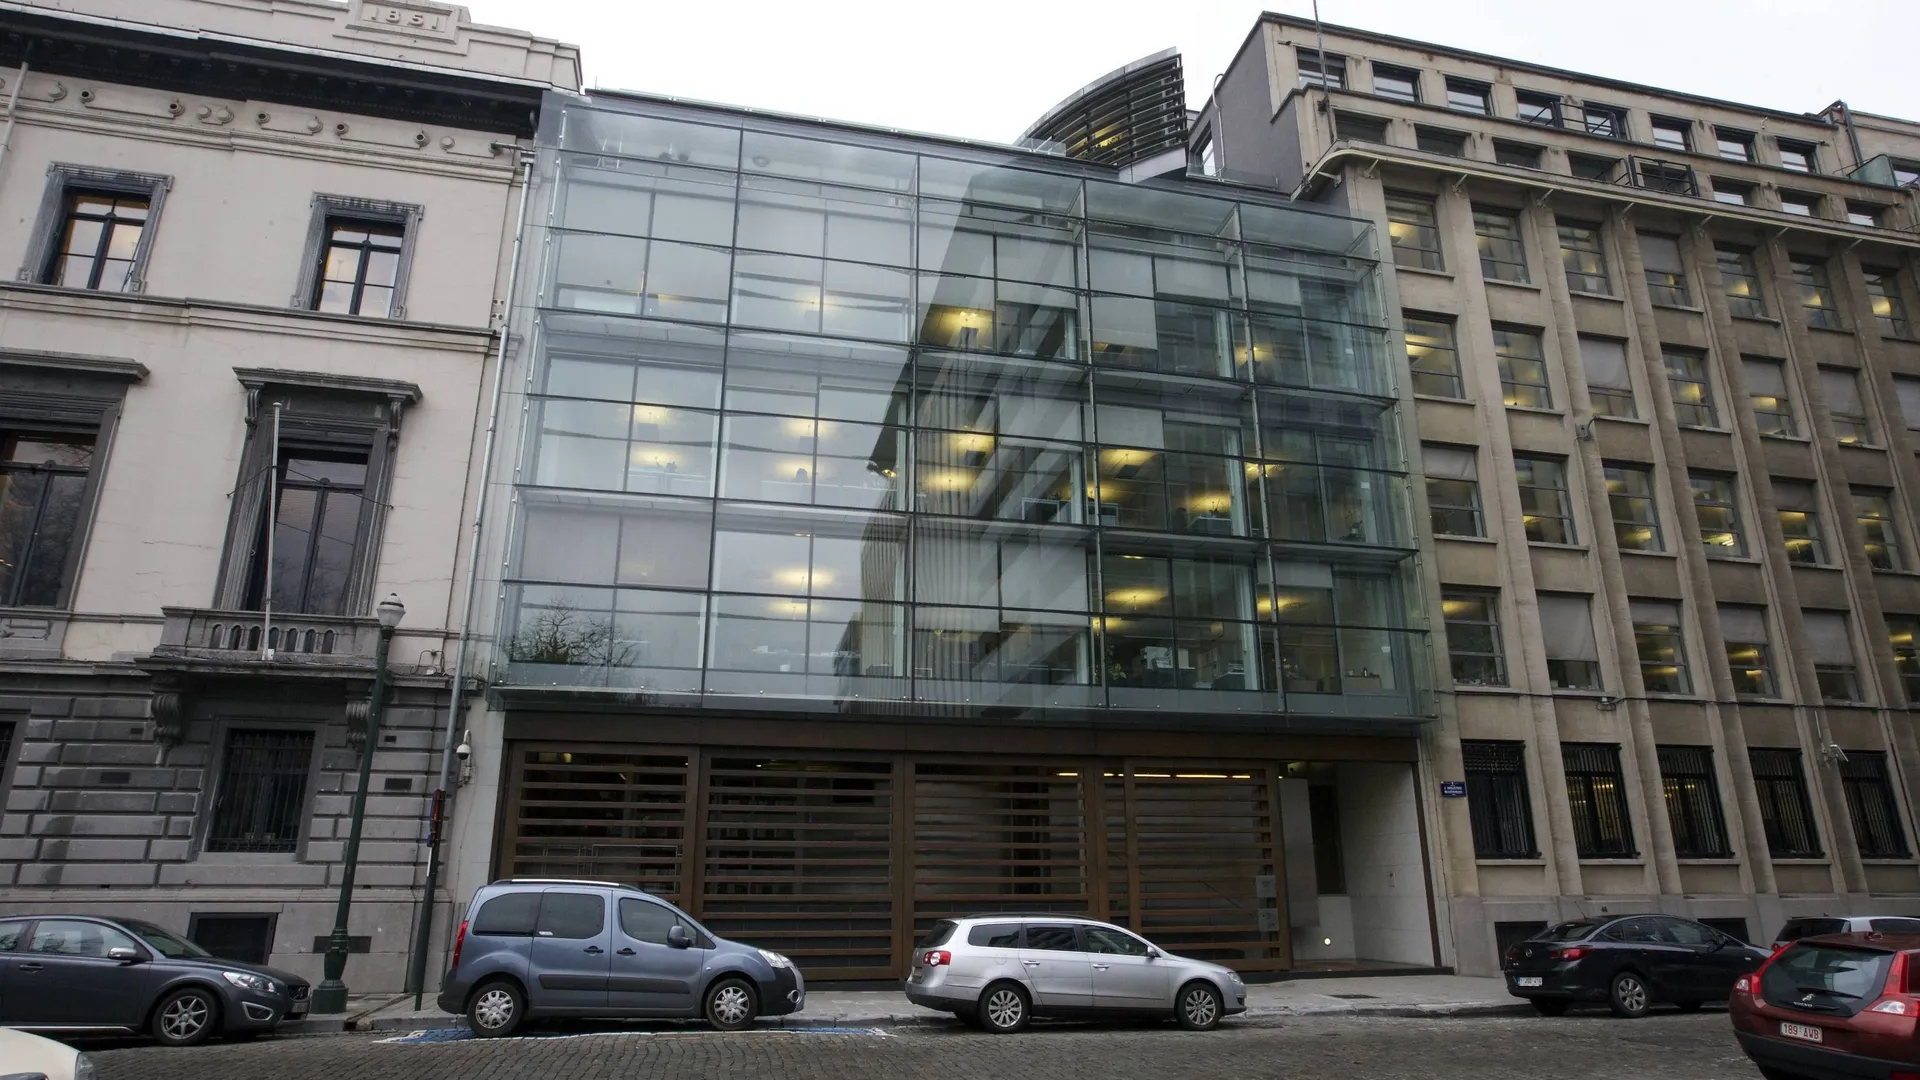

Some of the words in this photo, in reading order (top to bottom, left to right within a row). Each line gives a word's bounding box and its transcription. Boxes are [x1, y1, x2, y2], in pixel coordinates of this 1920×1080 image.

[369, 6, 440, 30] 1851
[1783, 1023, 1798, 1036] 189
[1803, 1027, 1819, 1040] AWB
